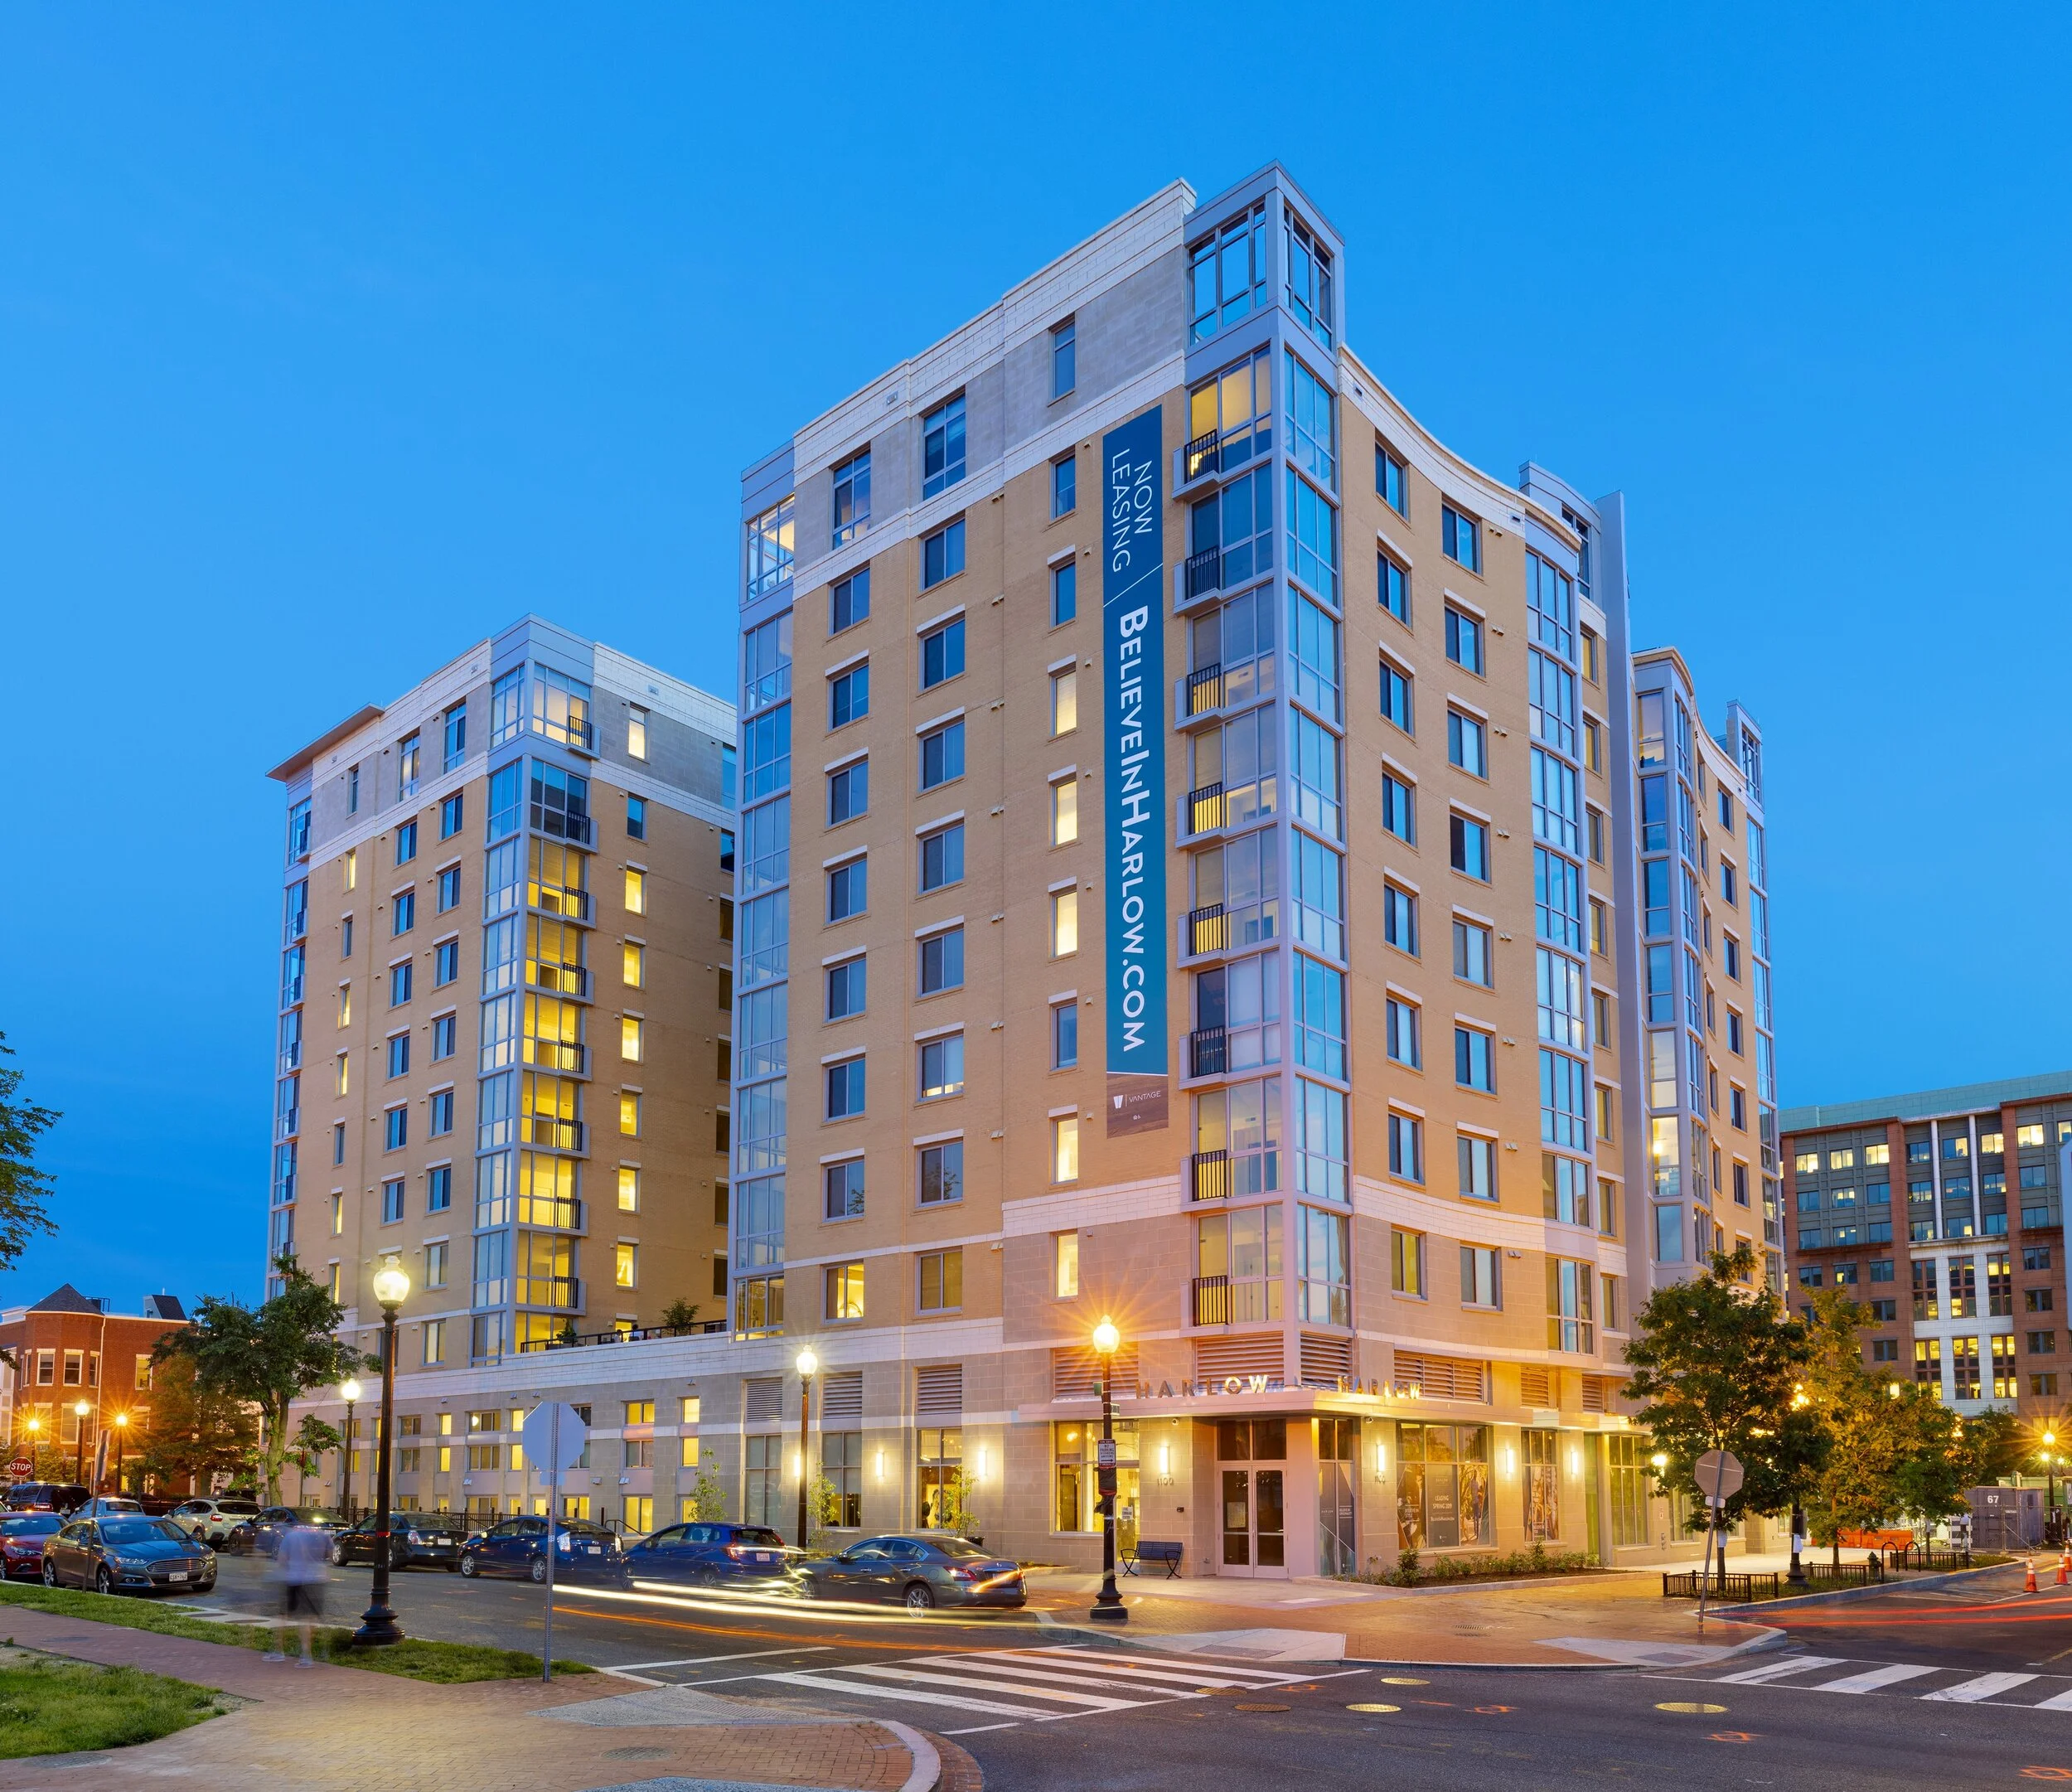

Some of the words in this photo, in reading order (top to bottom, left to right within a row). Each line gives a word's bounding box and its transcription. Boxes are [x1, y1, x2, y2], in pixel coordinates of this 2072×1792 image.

[1134, 459, 1154, 535] NOW
[1112, 448, 1131, 574] LEASING
[1128, 1090, 1161, 1103] VANTAGE
[1135, 1374, 1270, 1400] HARLOW
[1337, 1375, 1421, 1399] HARLOW
[11, 1462, 31, 1471] STOP
[1157, 1477, 1174, 1486] 1100
[1987, 1494, 1999, 1504] 67
